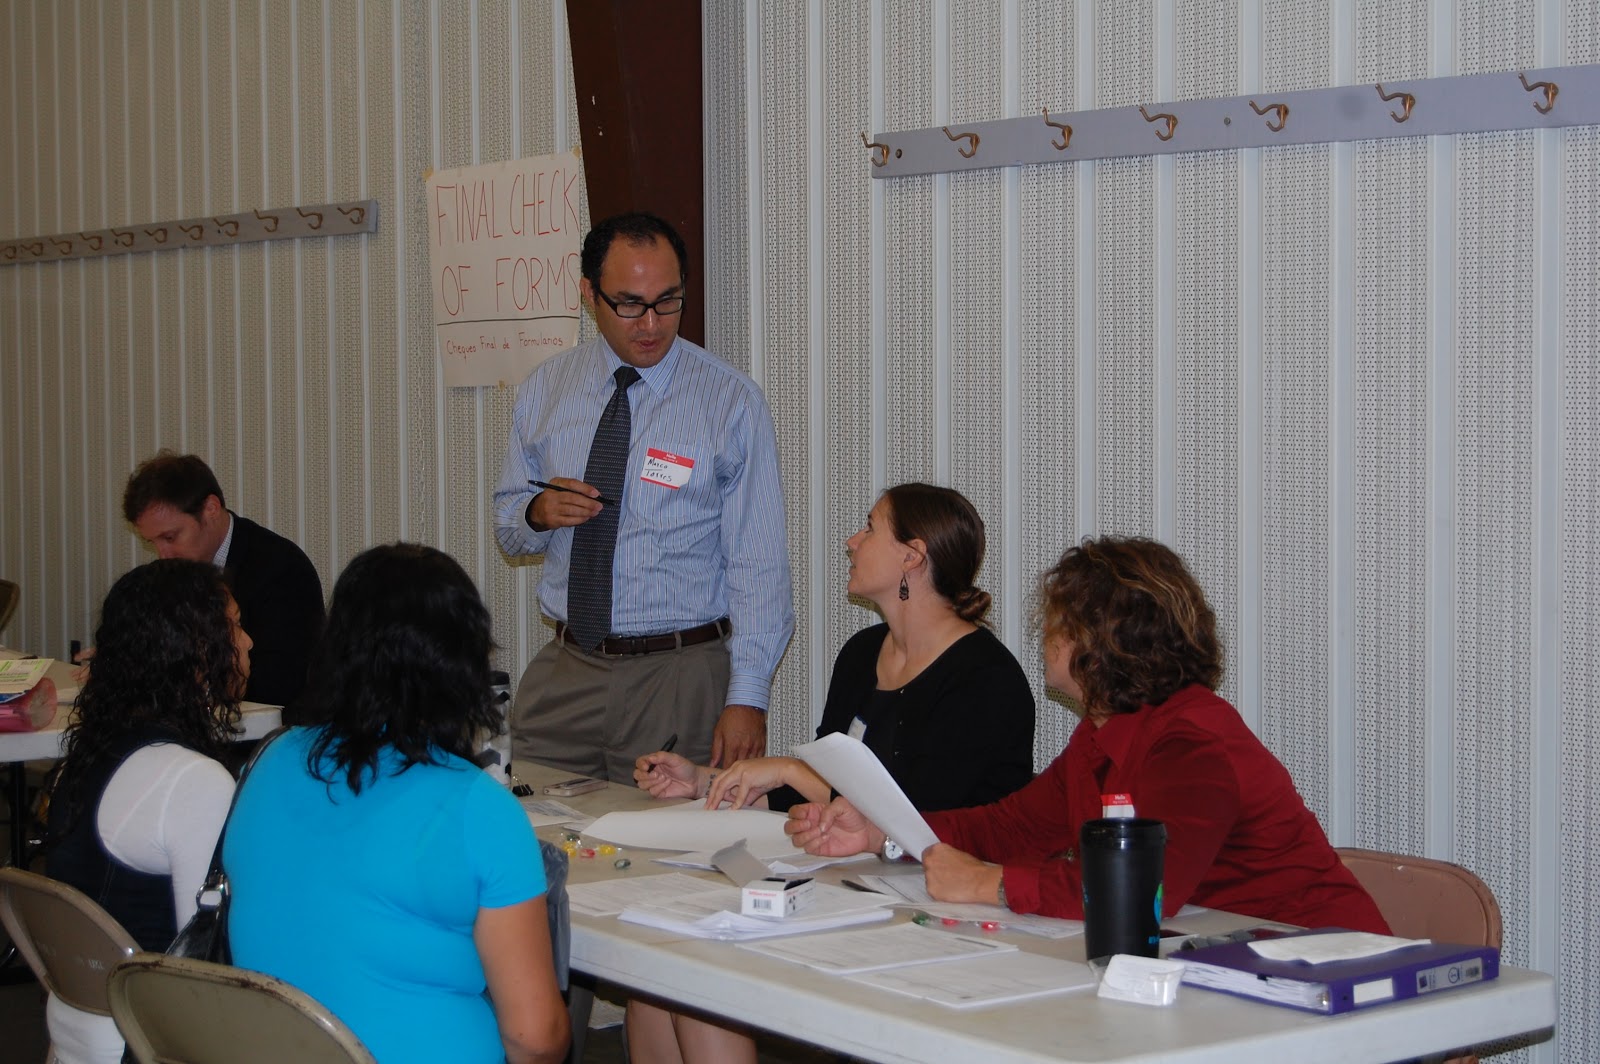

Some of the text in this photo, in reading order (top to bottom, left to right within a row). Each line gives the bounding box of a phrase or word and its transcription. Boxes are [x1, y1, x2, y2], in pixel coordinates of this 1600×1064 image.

[436, 168, 580, 247] FINAL CHECK
[441, 253, 580, 316] OF FORMS
[446, 331, 563, 362] Chequeo Final de Formularios
